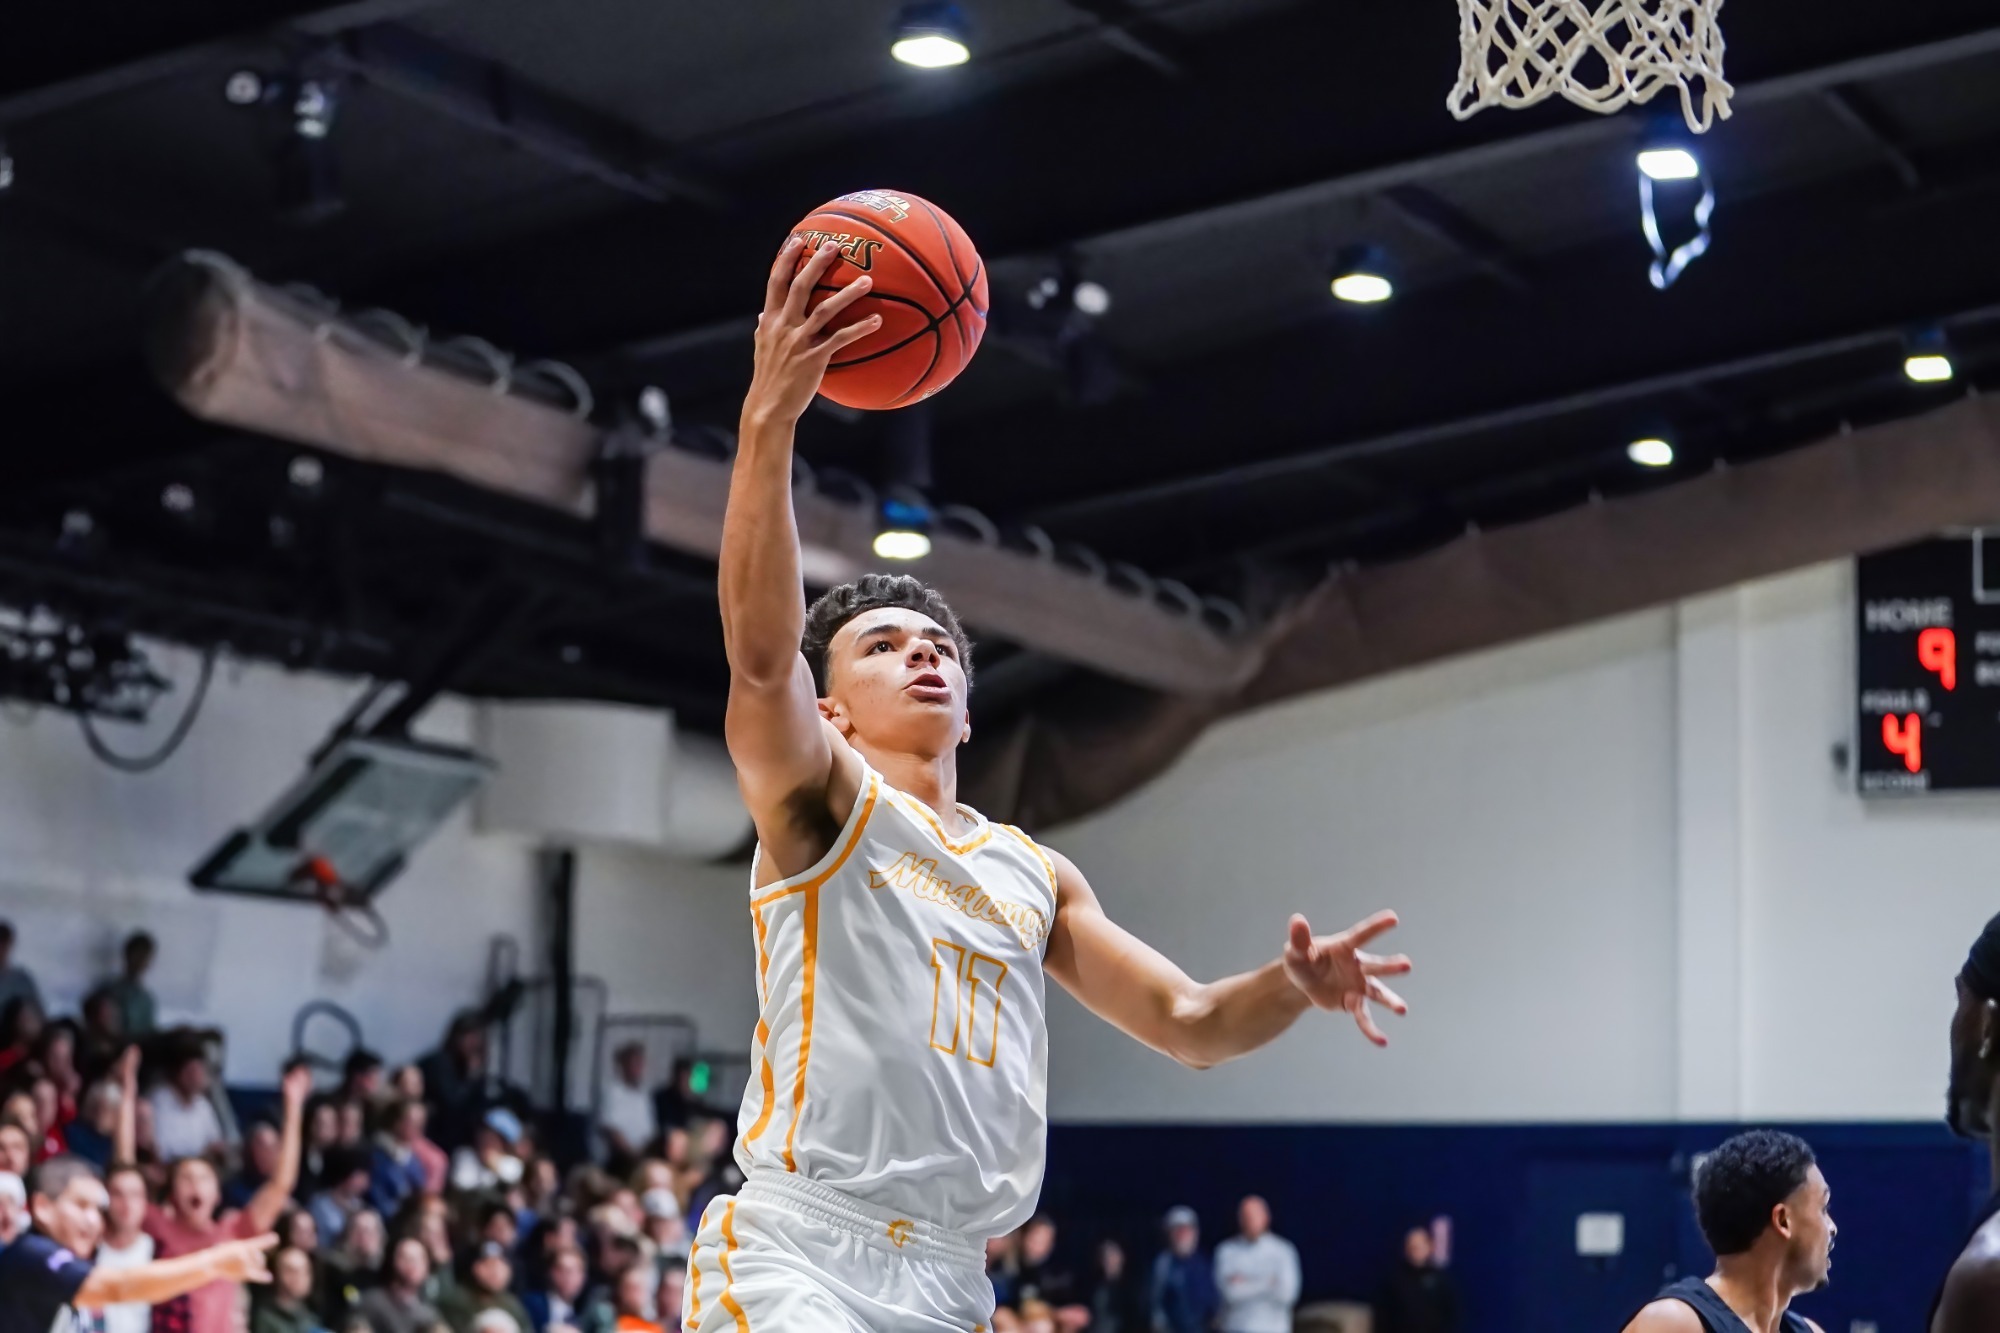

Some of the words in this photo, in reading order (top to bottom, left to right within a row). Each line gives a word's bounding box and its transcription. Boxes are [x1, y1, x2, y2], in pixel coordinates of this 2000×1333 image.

[775, 229, 884, 272] SPAL
[1918, 627, 1956, 690] 9
[1882, 713, 1921, 773] 4
[930, 937, 1008, 1068] 11
